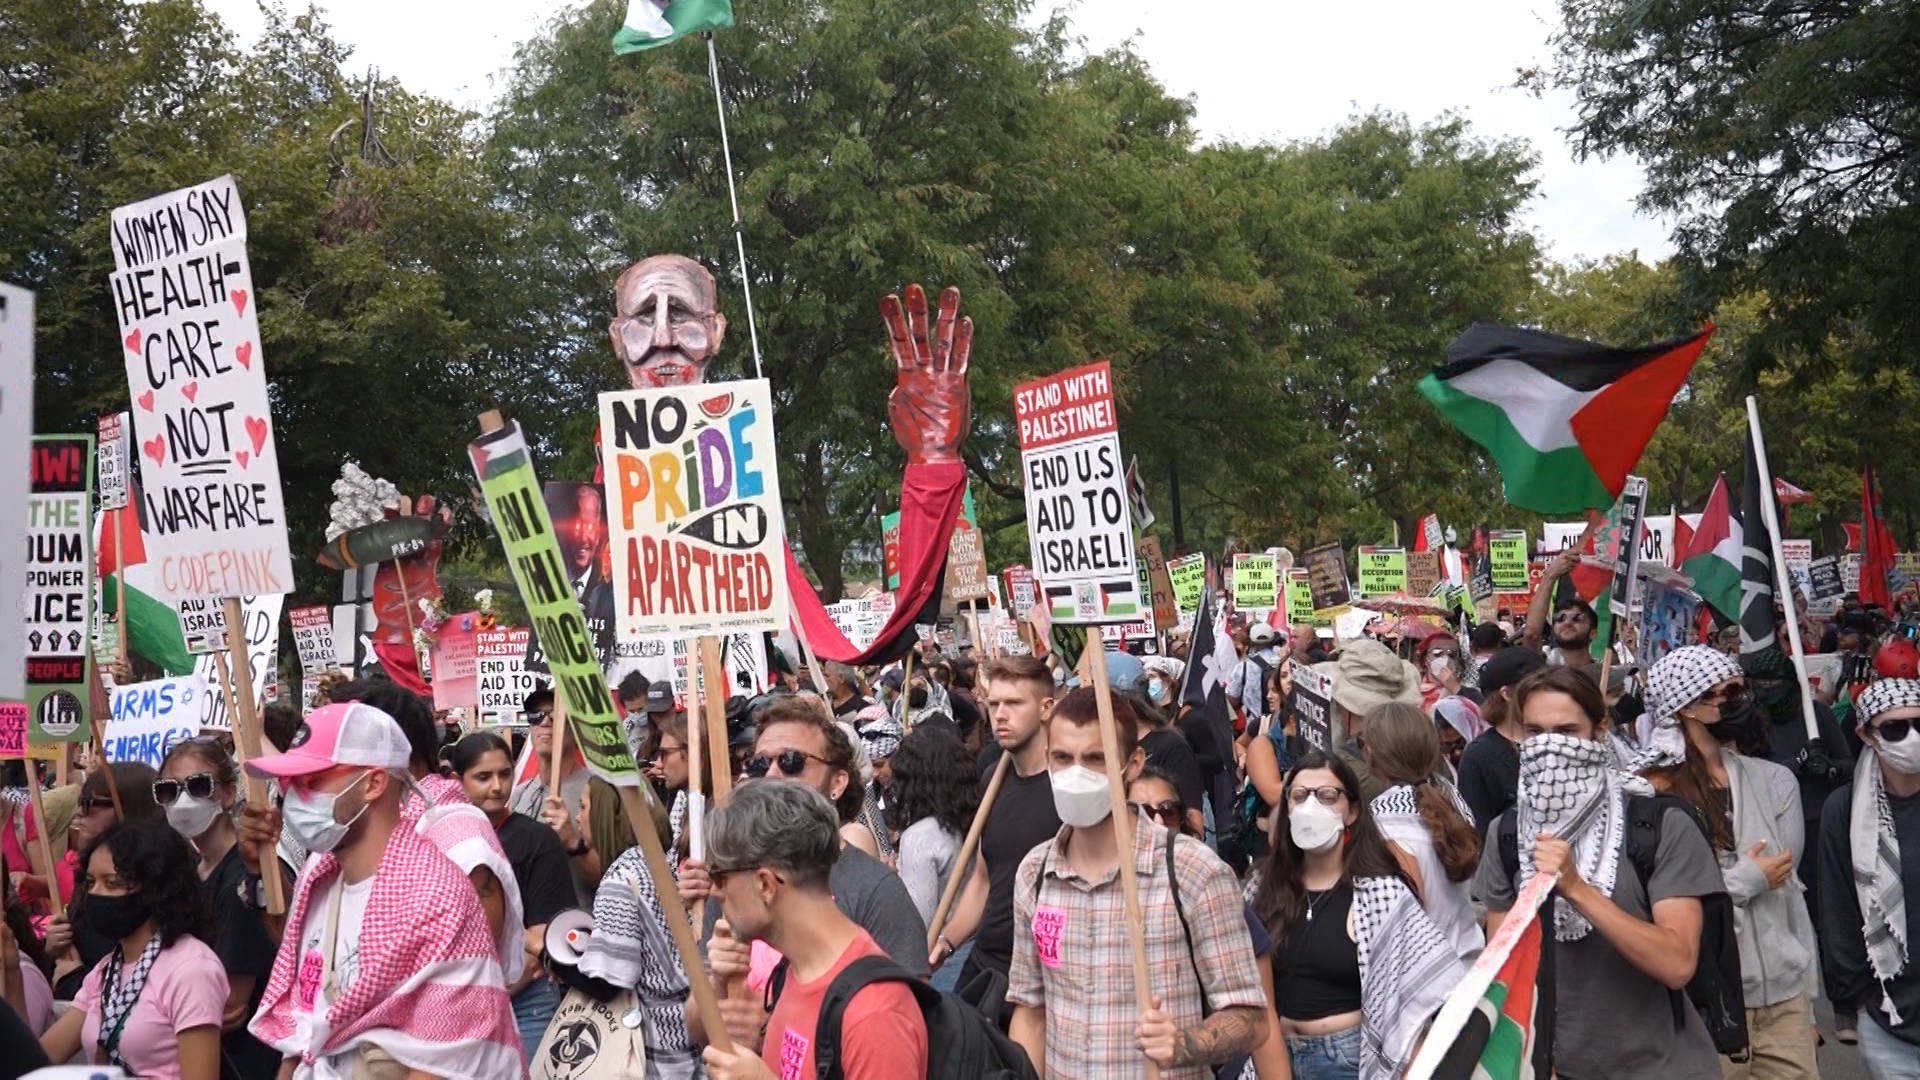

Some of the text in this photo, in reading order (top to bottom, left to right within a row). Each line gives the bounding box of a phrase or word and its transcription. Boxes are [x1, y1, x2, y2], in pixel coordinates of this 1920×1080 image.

[114, 187, 231, 267] WOMEN SAY
[116, 252, 241, 326] HEALTH-
[145, 321, 232, 390] CARE
[1017, 371, 1108, 415] STAND WITH
[165, 402, 234, 463] NOT
[612, 396, 687, 449] NO
[1021, 399, 1113, 444] PALESTINE!
[1030, 446, 1114, 491] END U.S
[29, 499, 80, 527] THE
[147, 483, 274, 535] WARFARE
[1037, 487, 1122, 534] AID TO
[1040, 532, 1129, 574] ISRAEL!
[1236, 561, 1273, 570] LONG LIVE
[26, 571, 84, 586] POWER
[161, 548, 281, 594] CODEPINK
[1171, 568, 1188, 577] END
[1238, 582, 1273, 592] INTIFADA
[34, 593, 83, 623] ICE
[296, 629, 312, 639] END
[300, 638, 332, 650] AID TO
[477, 633, 505, 644] STAND
[26, 662, 81, 679] PEOPLE
[481, 661, 504, 674] END
[481, 675, 532, 690] AID TO
[113, 683, 176, 721] ARMS
[1037, 912, 1064, 924] MAKE
[1035, 933, 1059, 947] NOT
[592, 1001, 619, 1034] BOOKS
